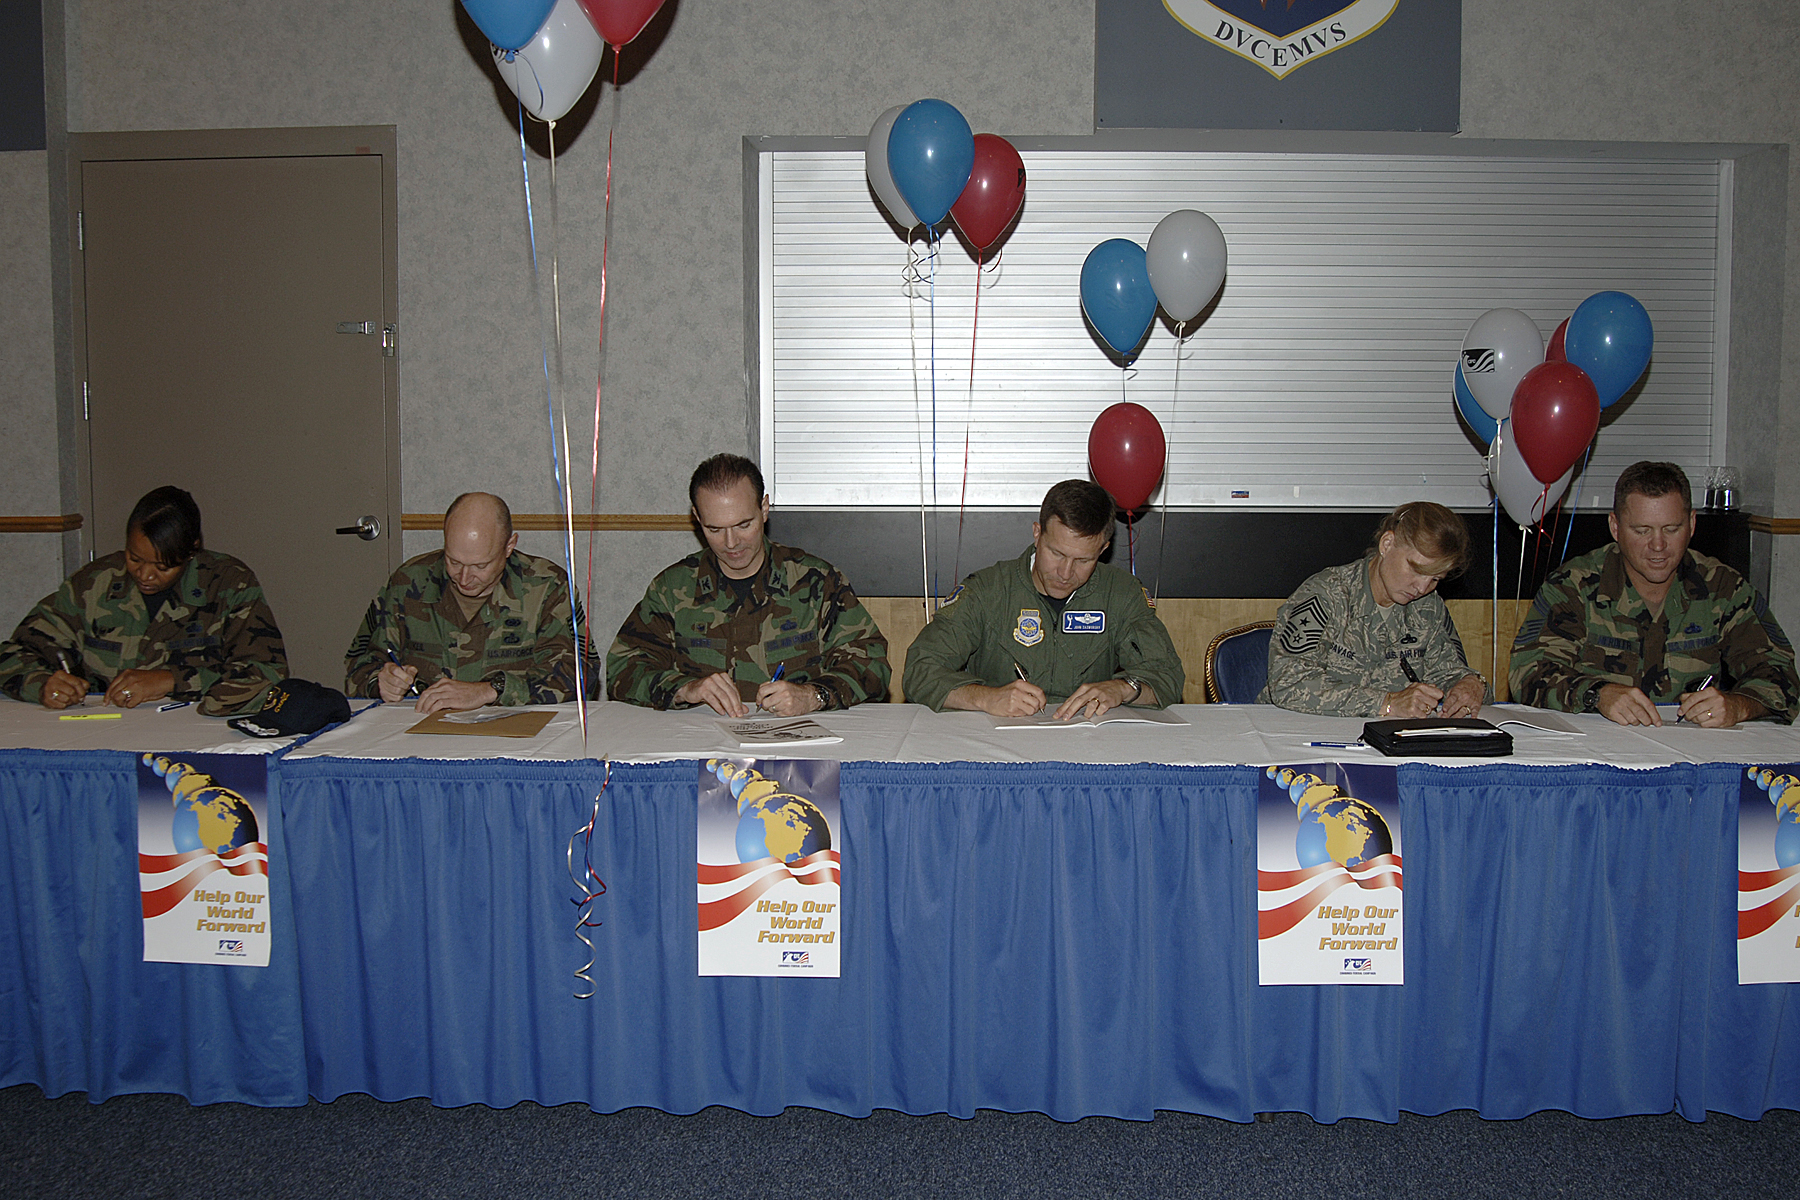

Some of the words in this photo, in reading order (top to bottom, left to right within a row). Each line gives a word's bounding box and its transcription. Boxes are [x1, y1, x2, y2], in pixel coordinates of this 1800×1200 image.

[1214, 20, 1347, 67] DVCEMVS
[193, 890, 231, 904] Help
[234, 891, 266, 904] Our
[207, 906, 254, 919] World
[756, 900, 799, 915] Help
[802, 901, 836, 913] Our
[1317, 905, 1360, 921] Help
[1364, 905, 1399, 919] Our
[197, 919, 266, 933] Forward
[770, 917, 824, 929] World
[1331, 922, 1386, 936] World
[757, 931, 835, 943] Forward
[1318, 937, 1398, 951] Forward
